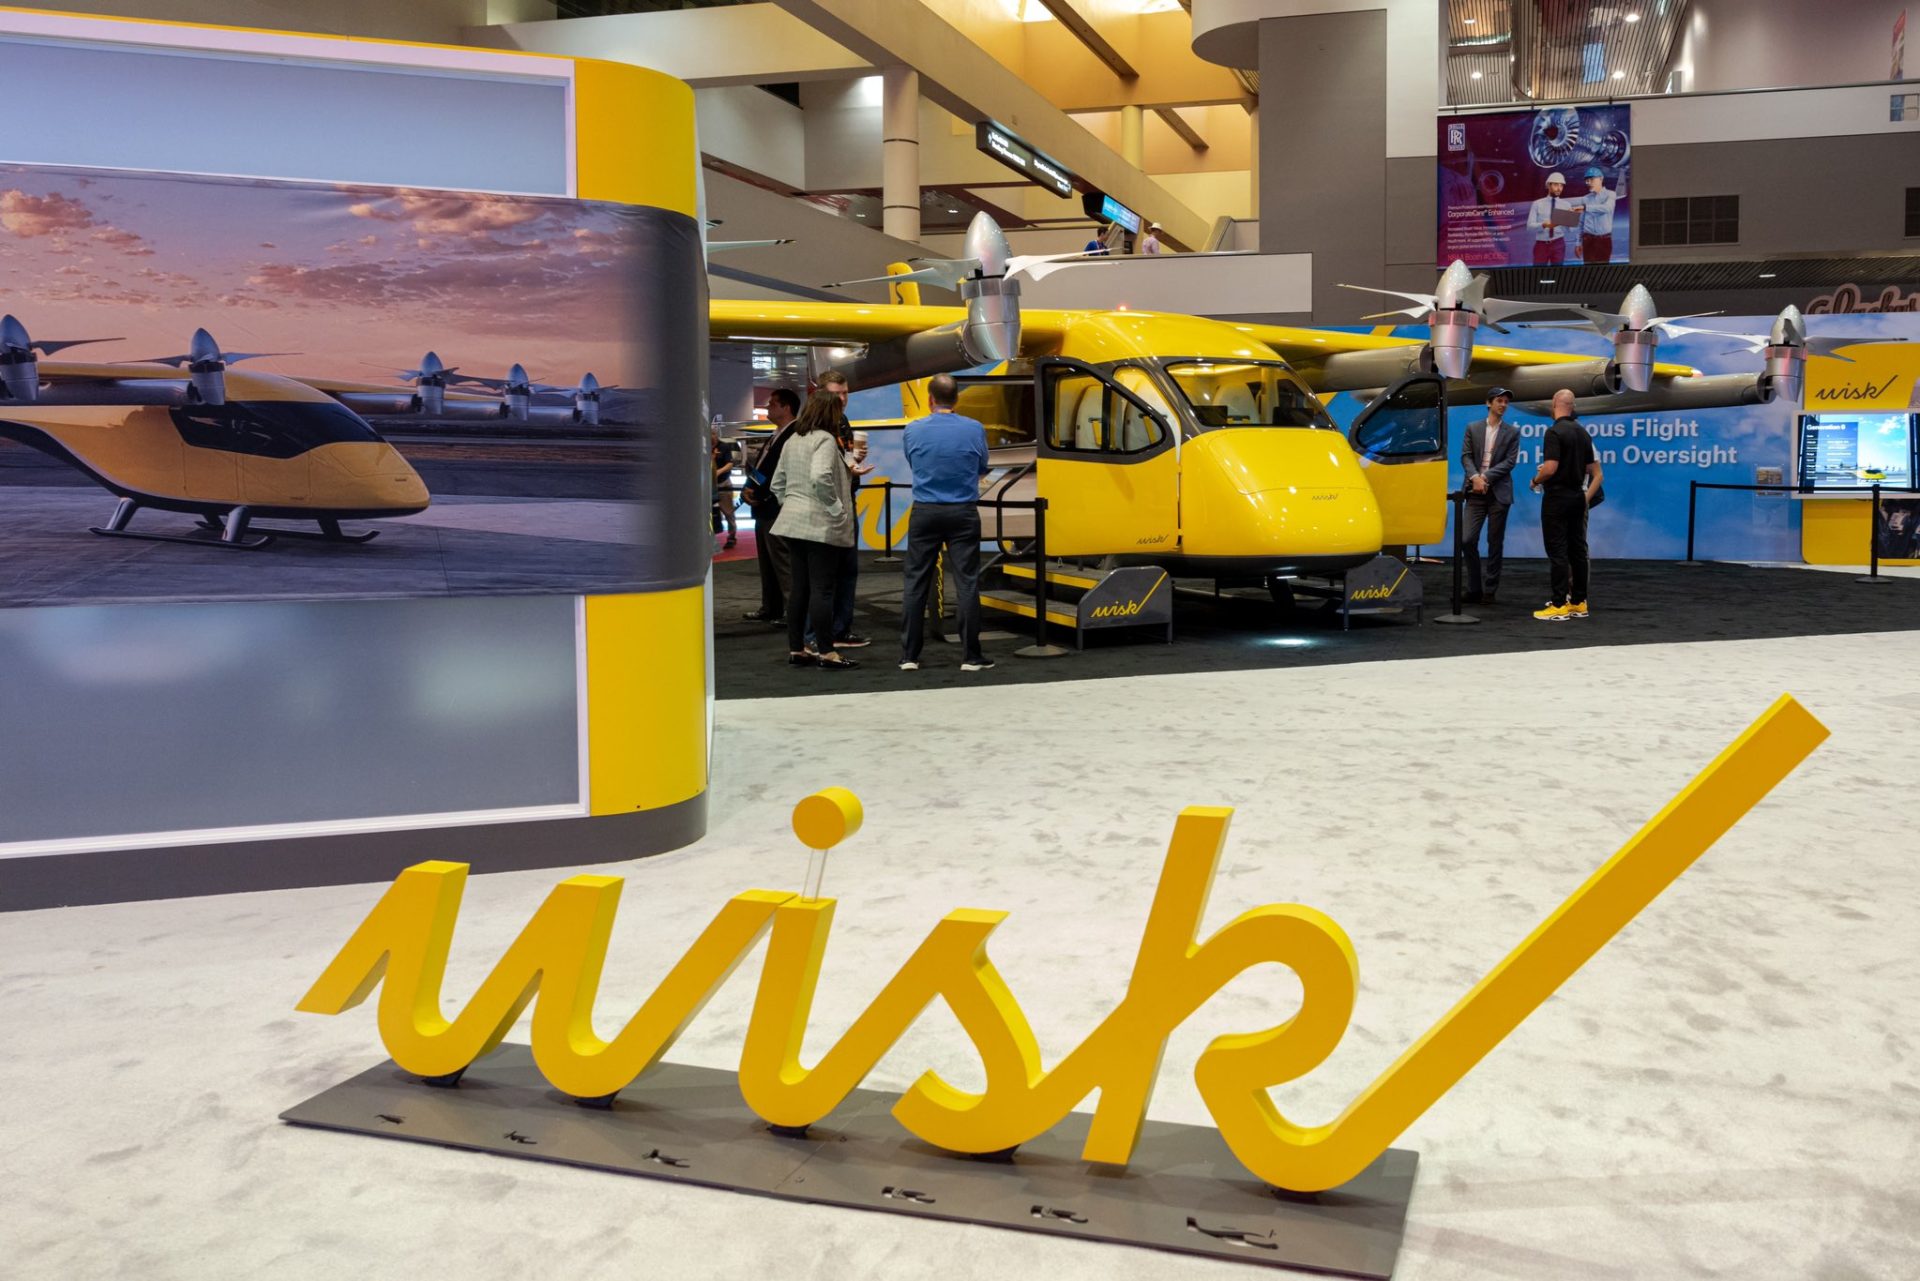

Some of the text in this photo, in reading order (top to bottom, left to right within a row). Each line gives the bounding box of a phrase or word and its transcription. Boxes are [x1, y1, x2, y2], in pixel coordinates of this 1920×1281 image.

[1815, 374, 1898, 400] wisk
[1632, 418, 1699, 441] Flight
[1622, 445, 1738, 468] Oversight
[1090, 571, 1167, 617] wisk
[1351, 567, 1408, 600] wisk
[294, 691, 1831, 1192] wisk
